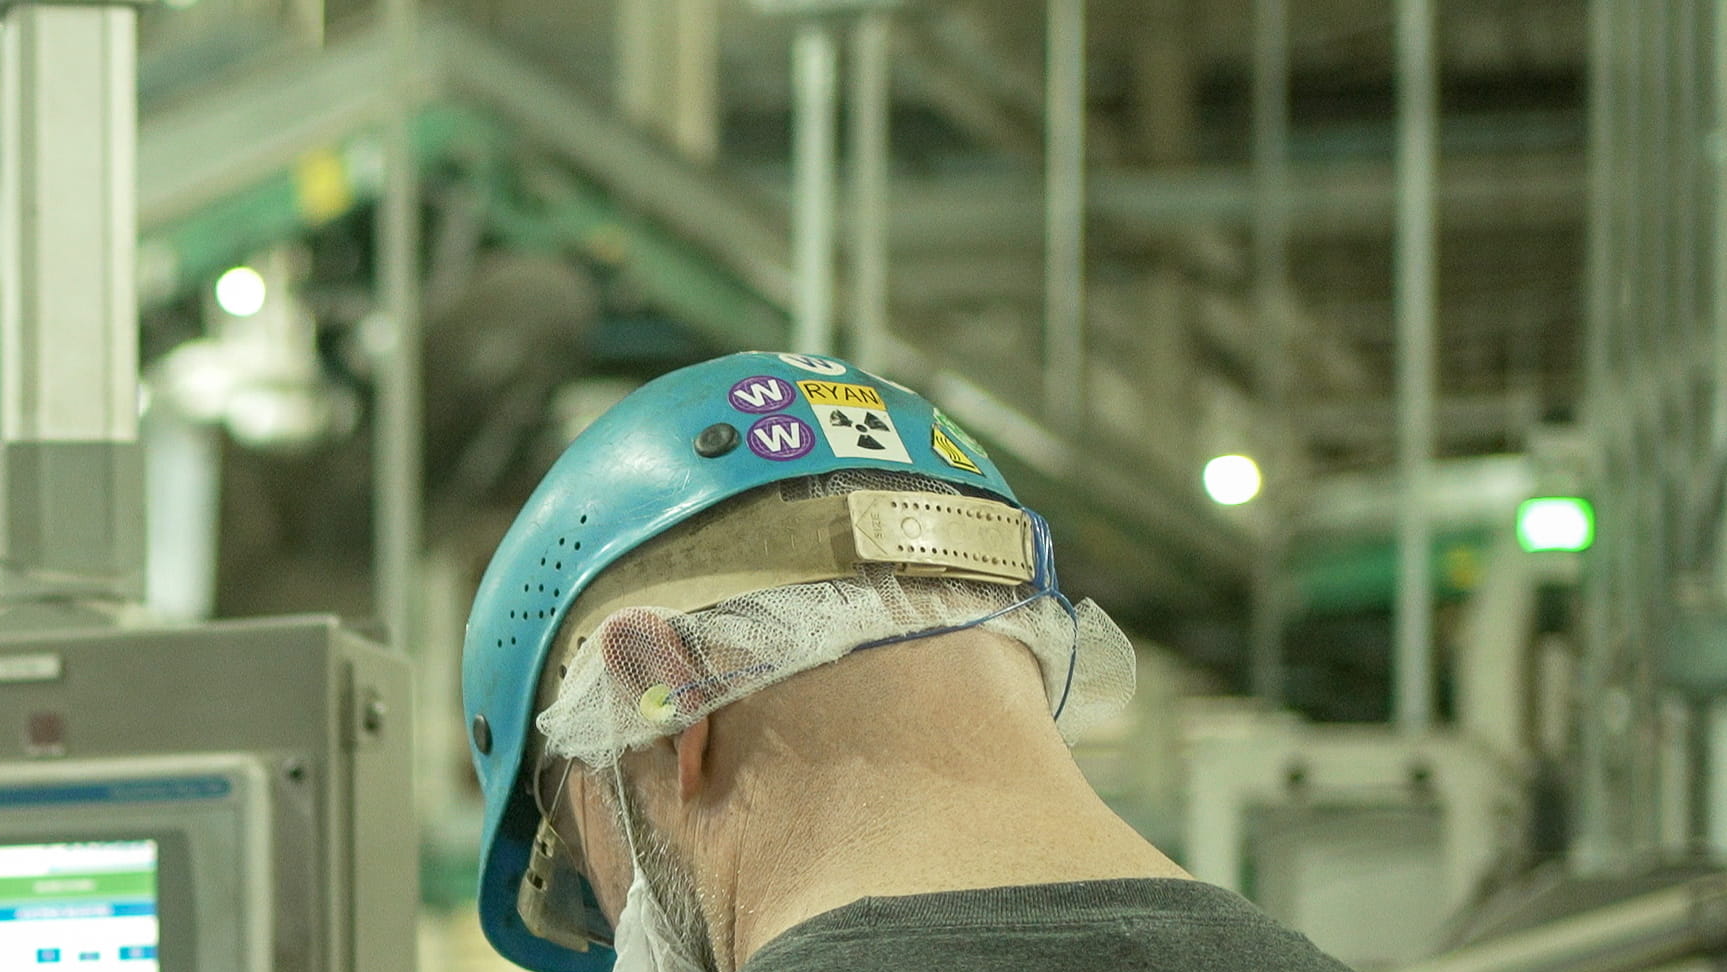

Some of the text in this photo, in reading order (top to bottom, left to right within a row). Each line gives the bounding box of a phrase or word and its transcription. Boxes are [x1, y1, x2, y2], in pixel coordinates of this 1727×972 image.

[734, 379, 784, 408] W
[803, 383, 879, 405] RYAN
[753, 422, 802, 453] W
